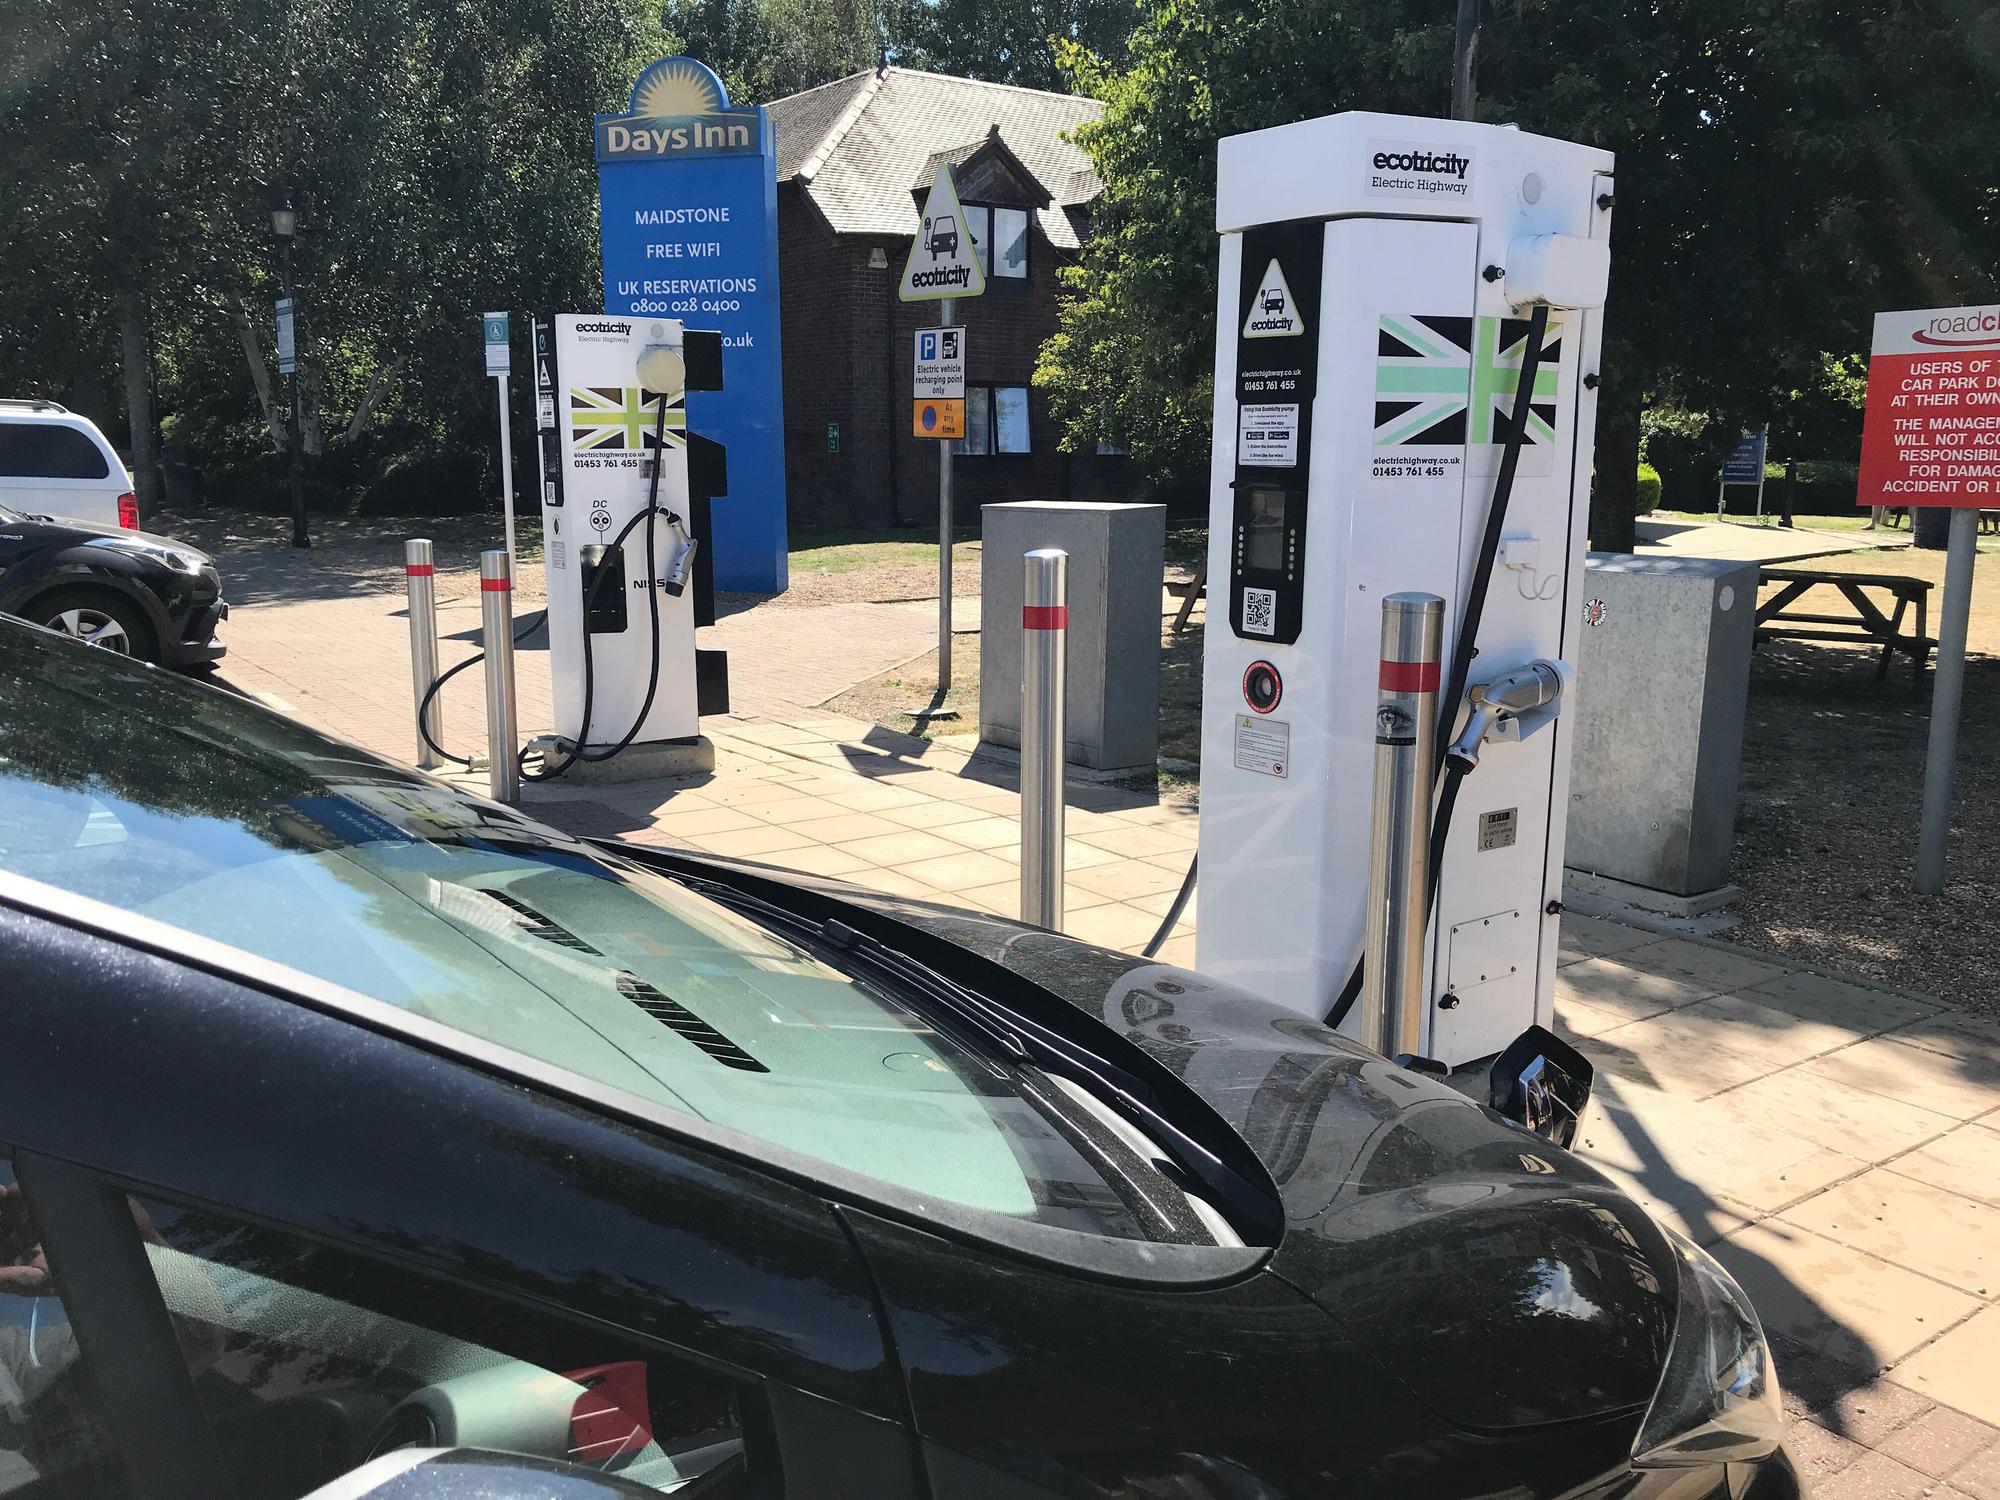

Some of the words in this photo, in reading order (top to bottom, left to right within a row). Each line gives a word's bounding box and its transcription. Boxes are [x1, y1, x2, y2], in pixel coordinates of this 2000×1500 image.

[608, 126, 688, 154] Days
[694, 122, 748, 148] Inn
[1373, 150, 1470, 179] ecotricity
[1372, 176, 1414, 189] Electric
[1417, 180, 1468, 195] Highway
[635, 208, 730, 224] MAIDSTONE
[647, 244, 683, 258] FREE
[687, 243, 720, 257] WIFI
[912, 264, 970, 288] ecotricity
[618, 281, 639, 295] UK
[644, 279, 757, 294] RESERVATIONS
[630, 298, 667, 313] 0800
[671, 297, 697, 312] 028
[702, 300, 740, 315] 0400
[576, 322, 632, 335] ecotricity
[1252, 318, 1293, 331] ecotricity
[1930, 310, 2000, 334] roadc
[721, 331, 754, 347] o.uk
[924, 336, 934, 358] P
[917, 365, 939, 373] Electric
[941, 364, 961, 373] vehicle
[1242, 369, 1301, 378] electrichighway.co.uk
[1910, 361, 1963, 376] USERS
[1969, 360, 1991, 373] OF
[916, 376, 945, 385] recharging
[1244, 381, 1264, 390] 01453
[1266, 381, 1278, 390] 761
[1280, 380, 1295, 389] 455
[1901, 378, 1932, 391] CAR
[1939, 377, 1979, 390] PARK
[1986, 376, 2000, 388] D
[932, 386, 945, 395] only
[945, 403, 953, 411] At
[1891, 395, 1909, 407] AT
[1915, 394, 1959, 406] THEIR
[944, 415, 954, 423] any
[1894, 418, 1923, 431] THE
[1894, 434, 1929, 446] WILL
[1935, 433, 1968, 446] NOT
[1374, 457, 1460, 466] electrichighway.co.uk
[1373, 467, 1402, 476] 01453
[1406, 467, 1422, 476] 761
[1426, 467, 1444, 476] 455
[1909, 465, 1940, 477] FOR
[1883, 480, 1960, 493] ACCIDENT
[1966, 481, 1989, 493] OR
[593, 500, 608, 508] DC
